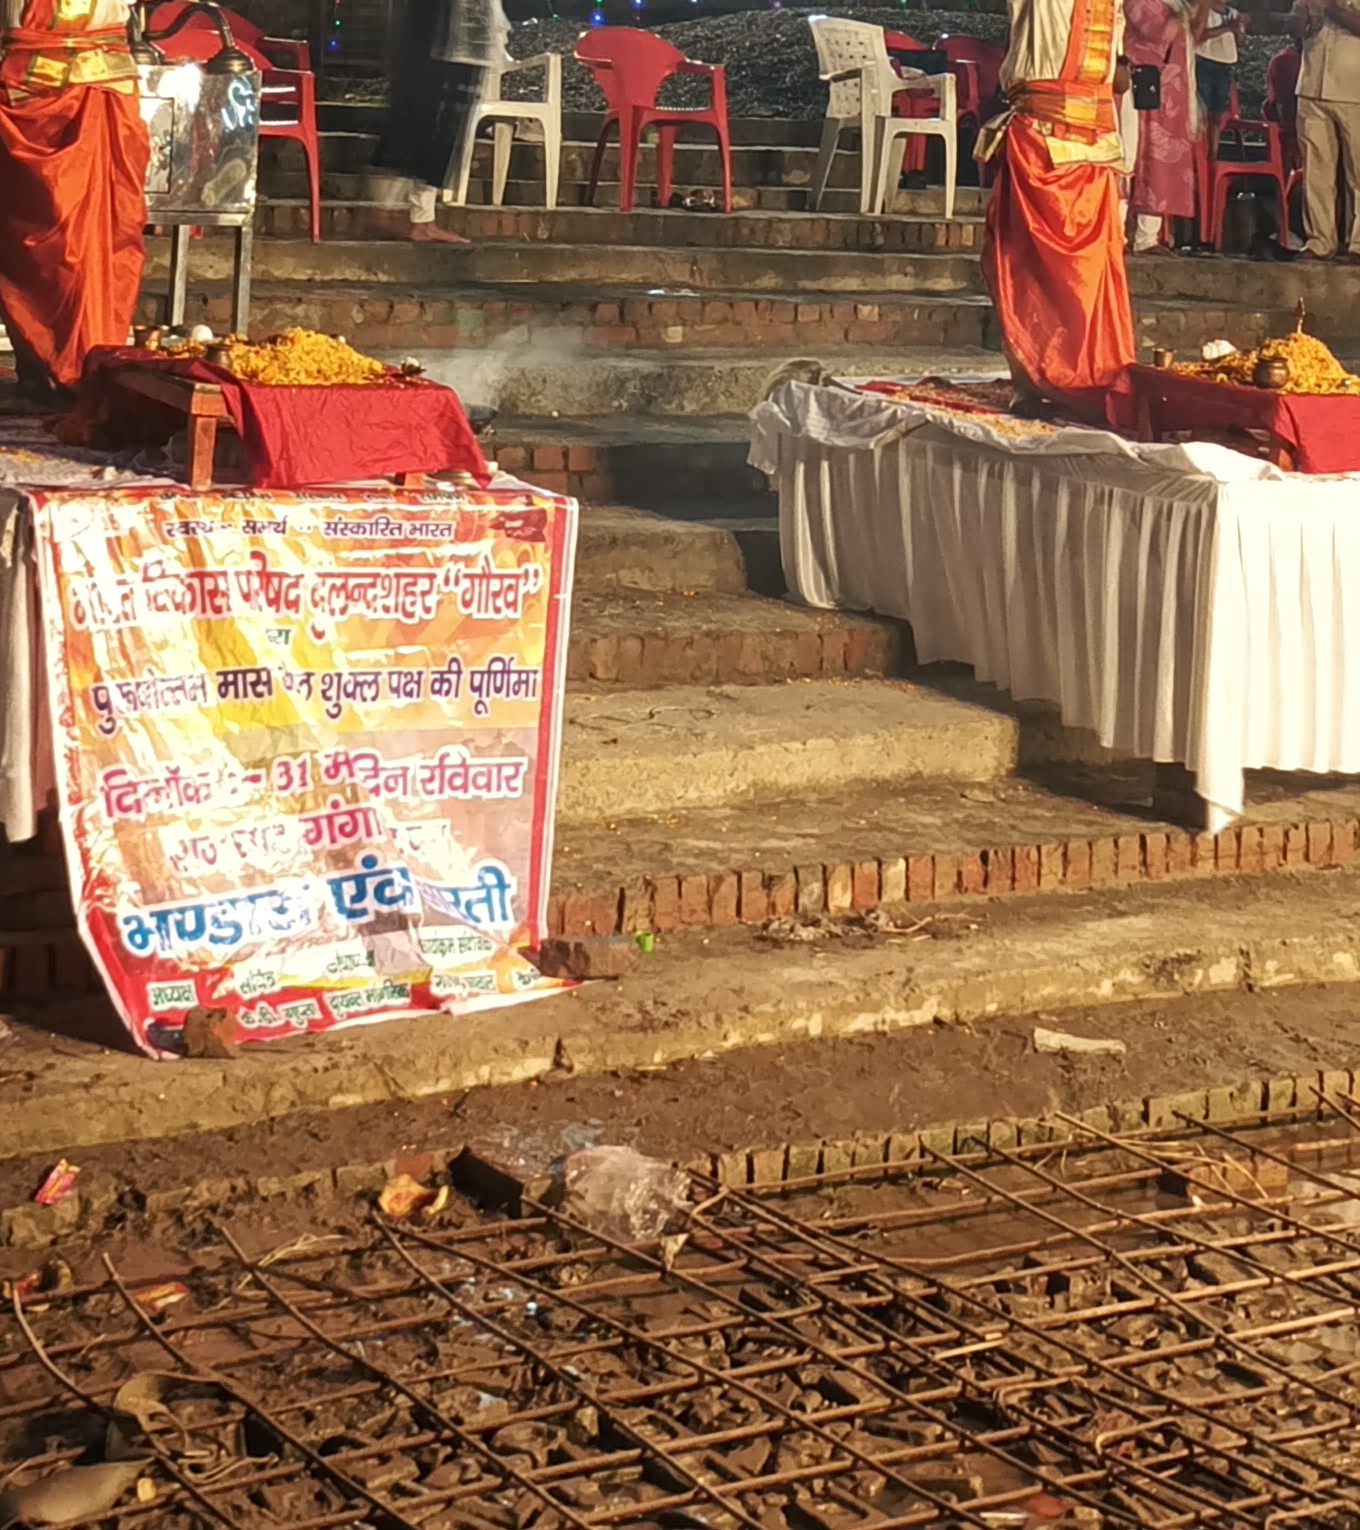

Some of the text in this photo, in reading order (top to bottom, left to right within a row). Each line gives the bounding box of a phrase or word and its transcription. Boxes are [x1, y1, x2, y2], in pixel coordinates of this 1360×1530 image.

[324, 516, 403, 537] संस्कारित
[409, 521, 455, 538] भारत
[216, 666, 273, 700] मास
[321, 669, 382, 720] शुक्ल
[388, 669, 424, 701] पक्ष
[430, 656, 463, 700] की
[469, 656, 540, 716] पूर्णिमा
[275, 758, 310, 792] 31
[300, 798, 386, 846] गंगा
